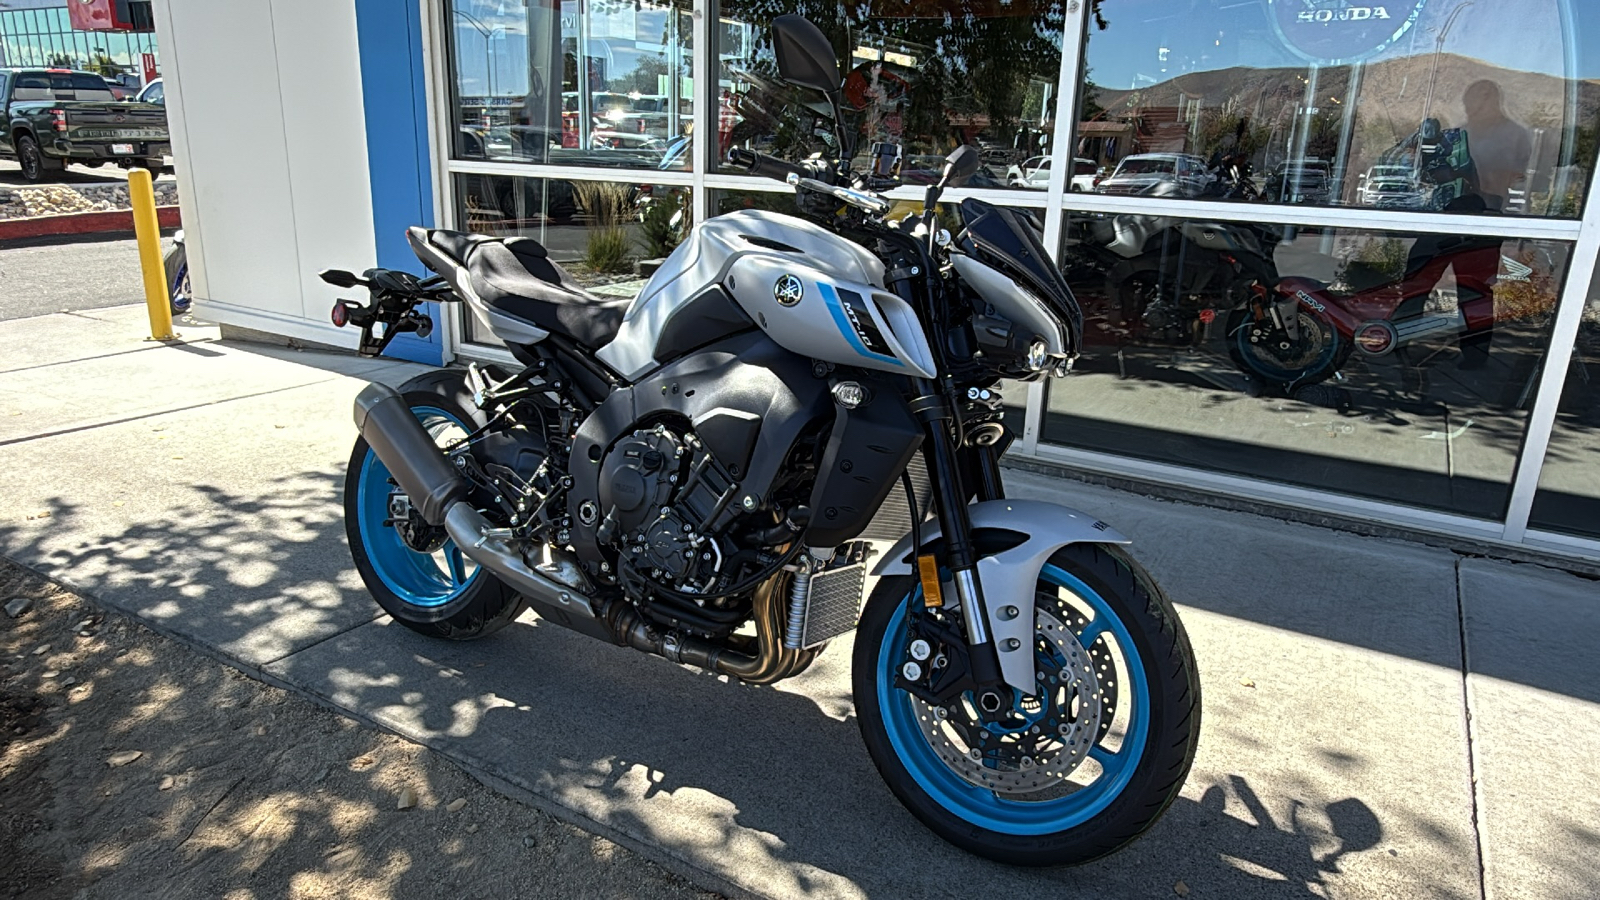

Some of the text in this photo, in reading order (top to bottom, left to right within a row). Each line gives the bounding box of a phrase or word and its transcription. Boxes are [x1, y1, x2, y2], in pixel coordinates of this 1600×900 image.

[1296, 6, 1390, 23] HONDA
[1496, 274, 1532, 283] HONDA
[843, 302, 873, 346] MT-10
